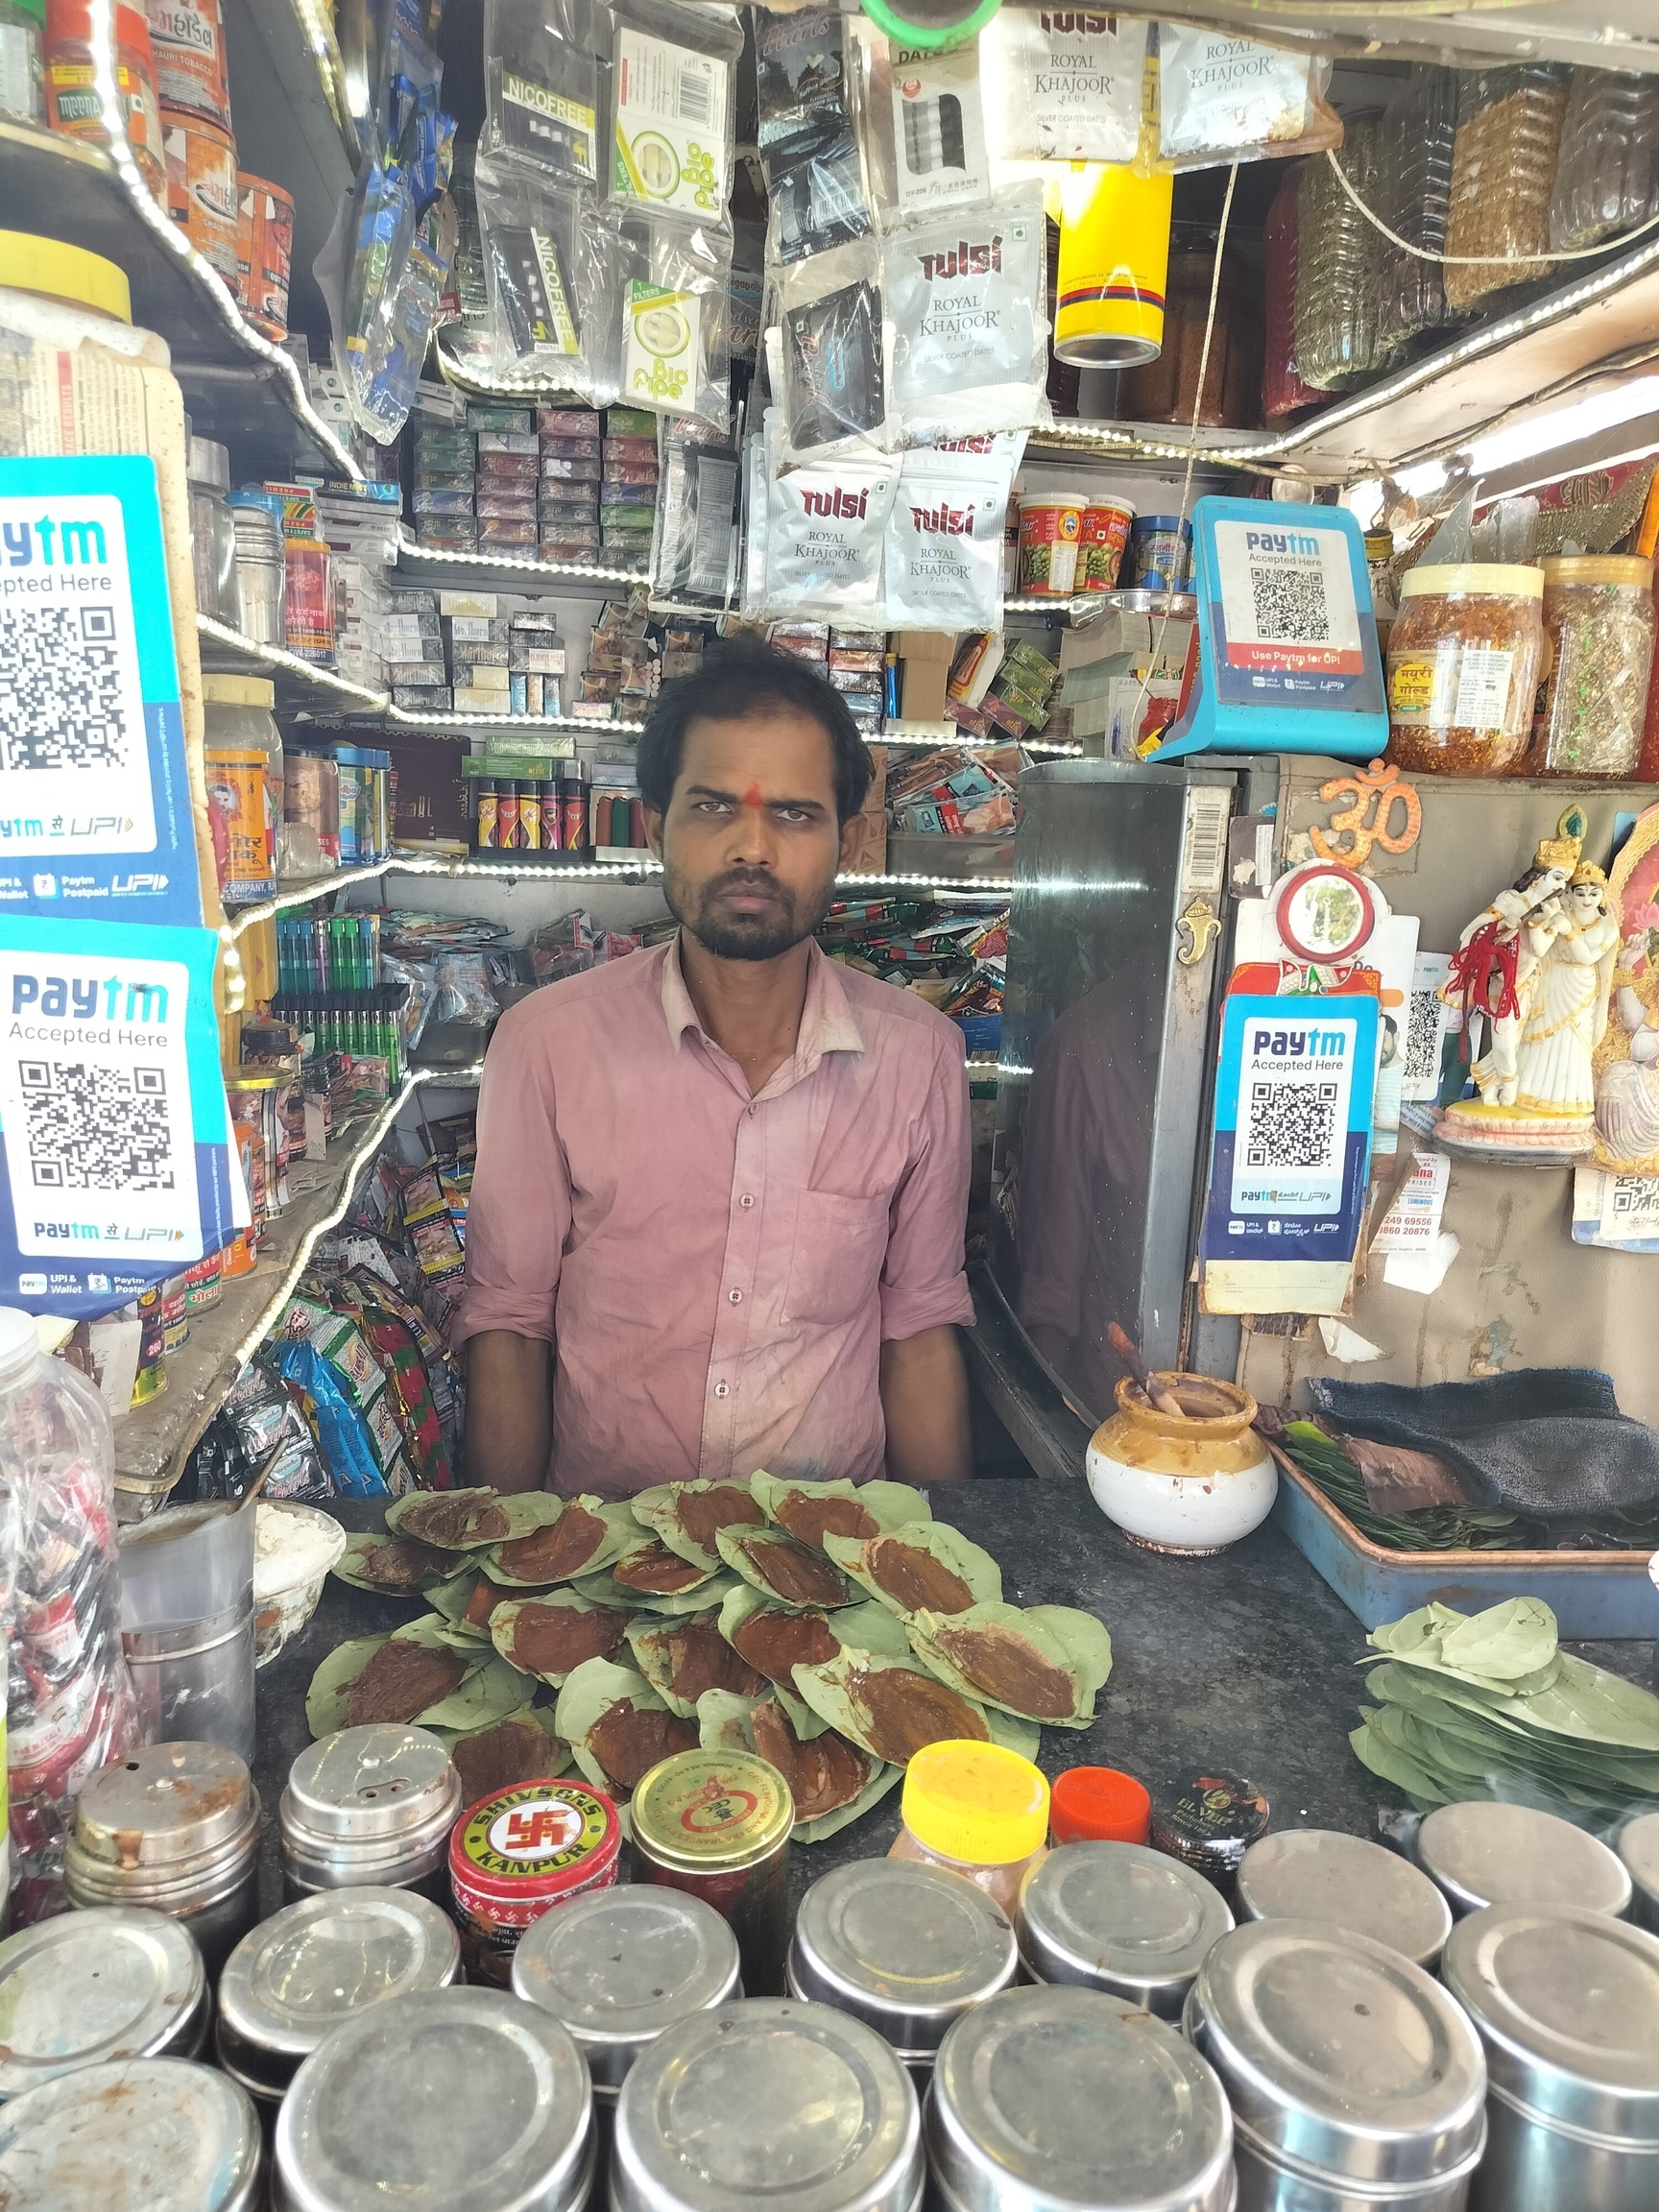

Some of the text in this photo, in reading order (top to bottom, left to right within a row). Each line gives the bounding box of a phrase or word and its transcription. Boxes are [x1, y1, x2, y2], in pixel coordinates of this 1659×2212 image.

[1206, 40, 1255, 60] ROYAL
[152, 50, 213, 75] HAURI TOBACCO
[1050, 54, 1096, 68] ROYAL
[1190, 57, 1272, 89] KHAJOOR
[1034, 75, 1111, 95] KHAJOOR
[1217, 81, 1243, 92] PLUS
[508, 77, 588, 123] NICOFREE
[1061, 94, 1086, 103] PLUS
[1037, 114, 1106, 124] SILVER COATED DATES
[535, 235, 575, 344] NICOFREE
[634, 288, 661, 301] FILTERS
[933, 295, 981, 311] ROYAL
[919, 311, 998, 337] KHAJOOR
[947, 333, 972, 342] PLUS
[924, 353, 944, 363] SILVER
[974, 347, 995, 356] DATES
[60, 384, 74, 428] RESULTS
[329, 481, 347, 491] INDIE
[808, 531, 847, 543] ROYAL
[795, 543, 857, 562] KHAJOOR
[920, 548, 957, 560] ROYAL
[1249, 554, 1322, 567] Accepted Here
[910, 562, 970, 579] KHAJOOR
[60, 573, 112, 591] Here
[1252, 651, 1340, 664] Use Paytm for UPI
[1401, 666, 1433, 682] मयूरी
[1320, 681, 1341, 689] UPI
[1400, 683, 1430, 695] गोल्ड
[71, 817, 123, 835] UPI
[13, 878, 22, 887] &
[61, 875, 95, 887] Paytm
[112, 874, 160, 892] UPI
[62, 886, 109, 899] Postpaid
[10, 1022, 168, 1048] Accepted Here
[1251, 1059, 1343, 1072] Accepted Here
[1299, 1192, 1327, 1201] UPI
[1382, 1215, 1402, 1224] 249
[106, 1222, 118, 1236] से
[125, 1227, 175, 1241] UPI
[1313, 1223, 1335, 1232] UPI
[114, 1276, 145, 1285] Paytm
[50, 1285, 83, 1294] Wallet
[720, 1774, 739, 1786] PAN
[473, 1786, 603, 1826] SHIVSONS
[702, 1798, 732, 1815] CEC
[1177, 1797, 1196, 1813] EL
[744, 1817, 762, 1832] AND
[676, 1829, 744, 1845] FRAGRANCES
[476, 1842, 589, 1875] KANPUR
